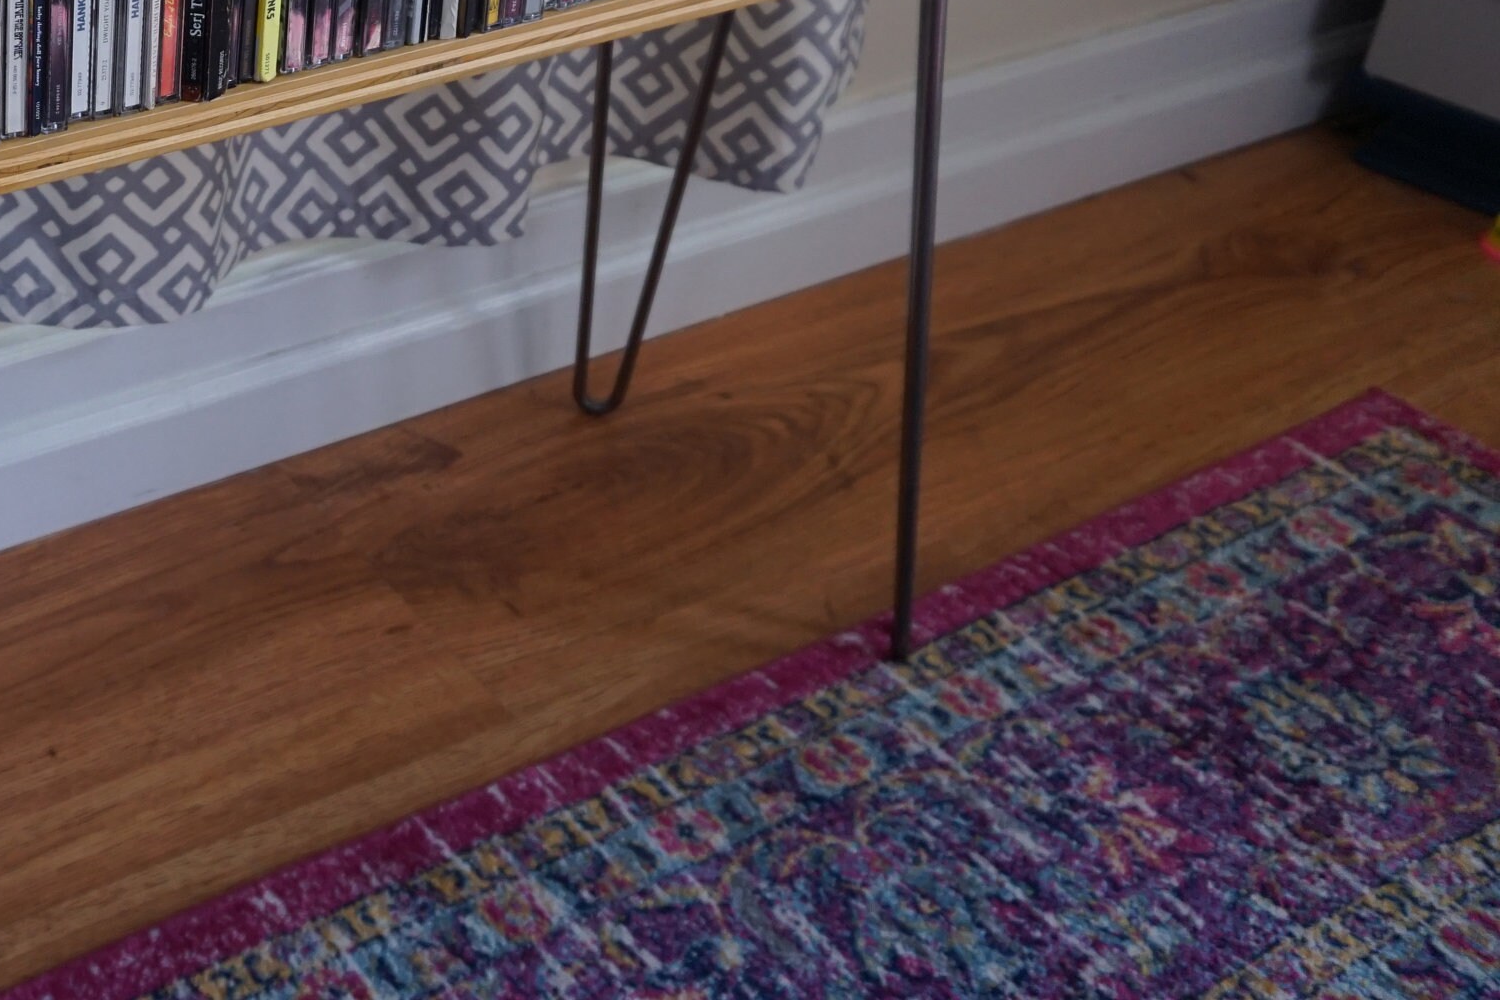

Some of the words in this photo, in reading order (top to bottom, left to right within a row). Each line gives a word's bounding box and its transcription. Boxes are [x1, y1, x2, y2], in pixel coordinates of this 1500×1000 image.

[34, 6, 43, 20] baby
[34, 22, 42, 42] darling
[102, 14, 110, 44] DWIGHT
[163, 14, 175, 38] Eagles
[190, 12, 205, 37] Serj
[34, 68, 42, 87] honey
